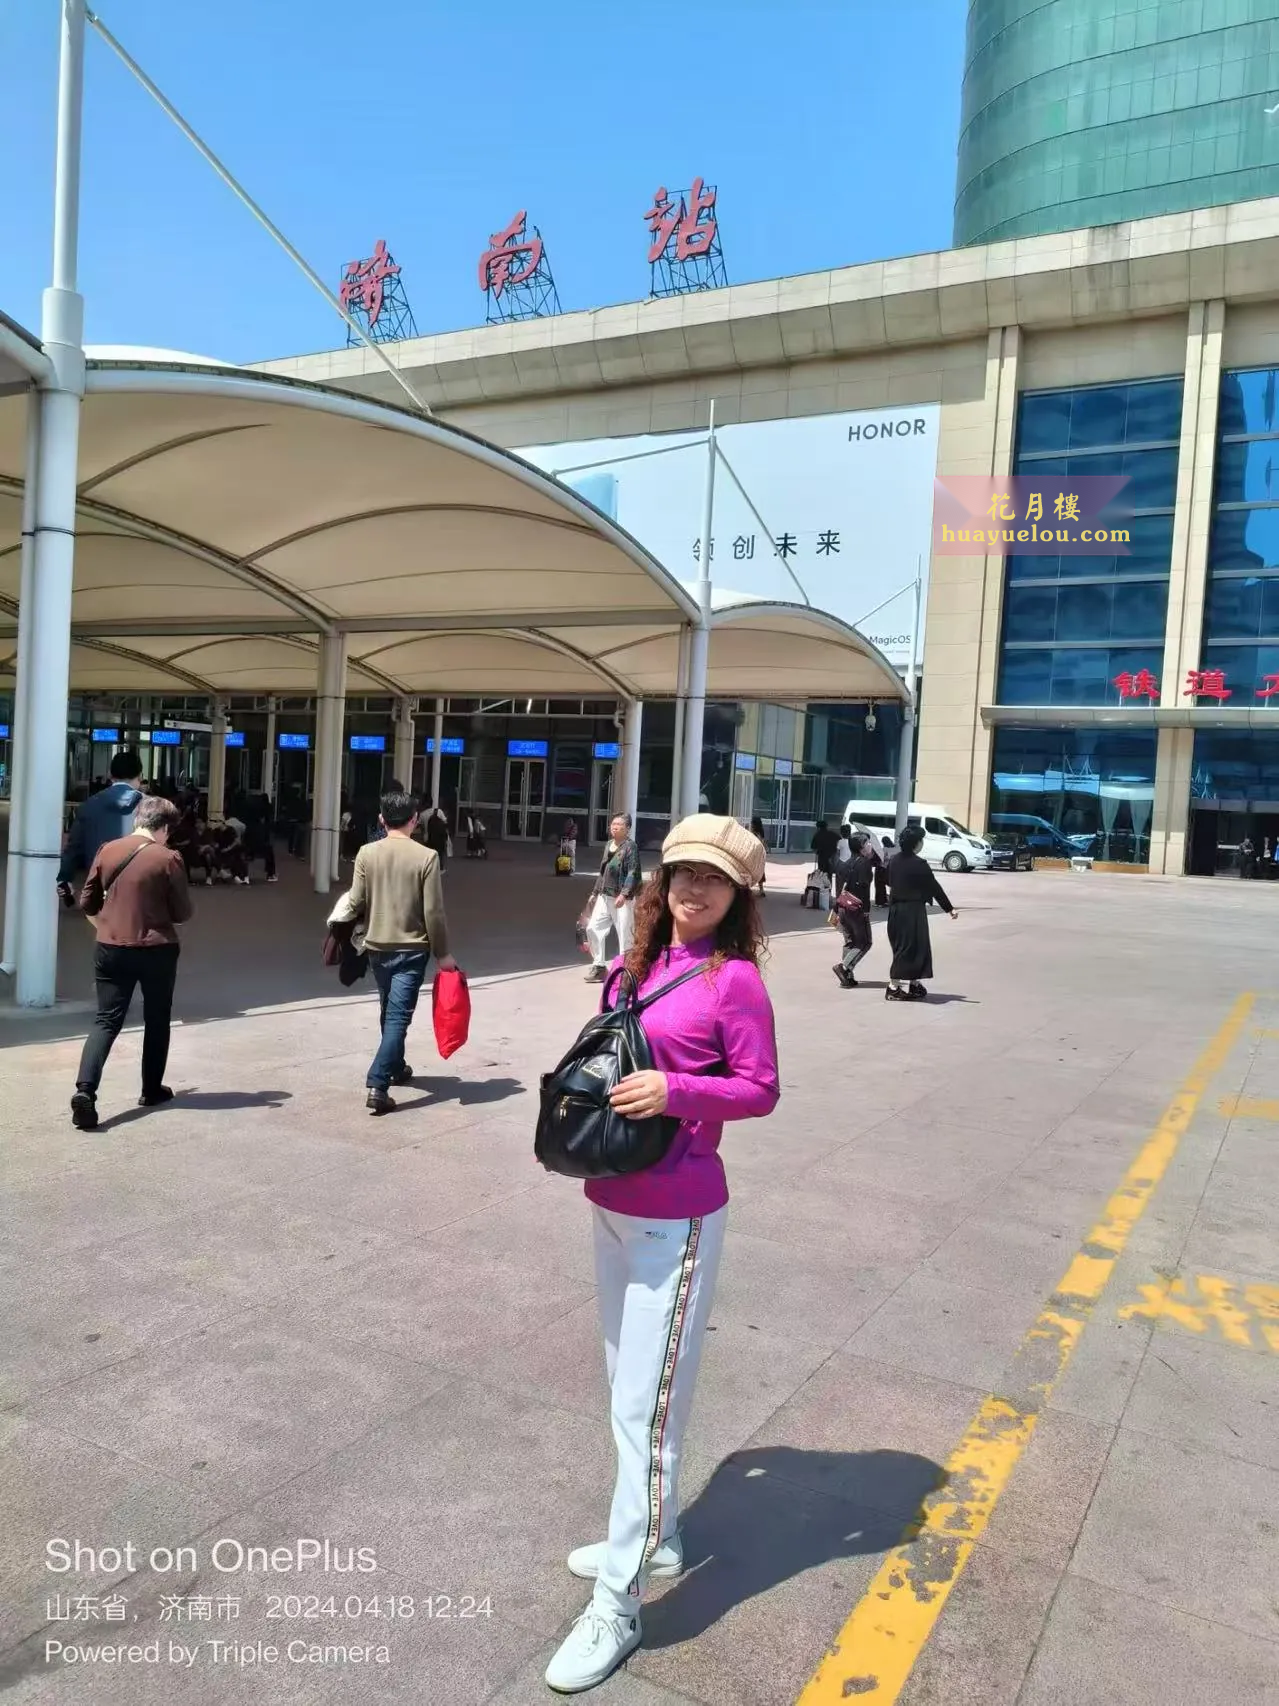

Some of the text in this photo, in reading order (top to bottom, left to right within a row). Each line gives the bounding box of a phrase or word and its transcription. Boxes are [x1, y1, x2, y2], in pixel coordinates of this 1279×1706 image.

[848, 419, 927, 442] HONOR
[688, 1241, 697, 1257] LOVE
[682, 1266, 692, 1283] LOVE
[677, 1294, 686, 1310] LOVE
[672, 1321, 681, 1337] LOVE
[667, 1347, 676, 1365] LOVE
[661, 1374, 671, 1391] LOVE
[657, 1402, 666, 1418] LOVE
[652, 1426, 661, 1444] LOVE
[652, 1455, 661, 1473] LOVE
[651, 1483, 659, 1501] LOVE
[651, 1515, 660, 1532] LOVE
[645, 1541, 656, 1560] LOVE
